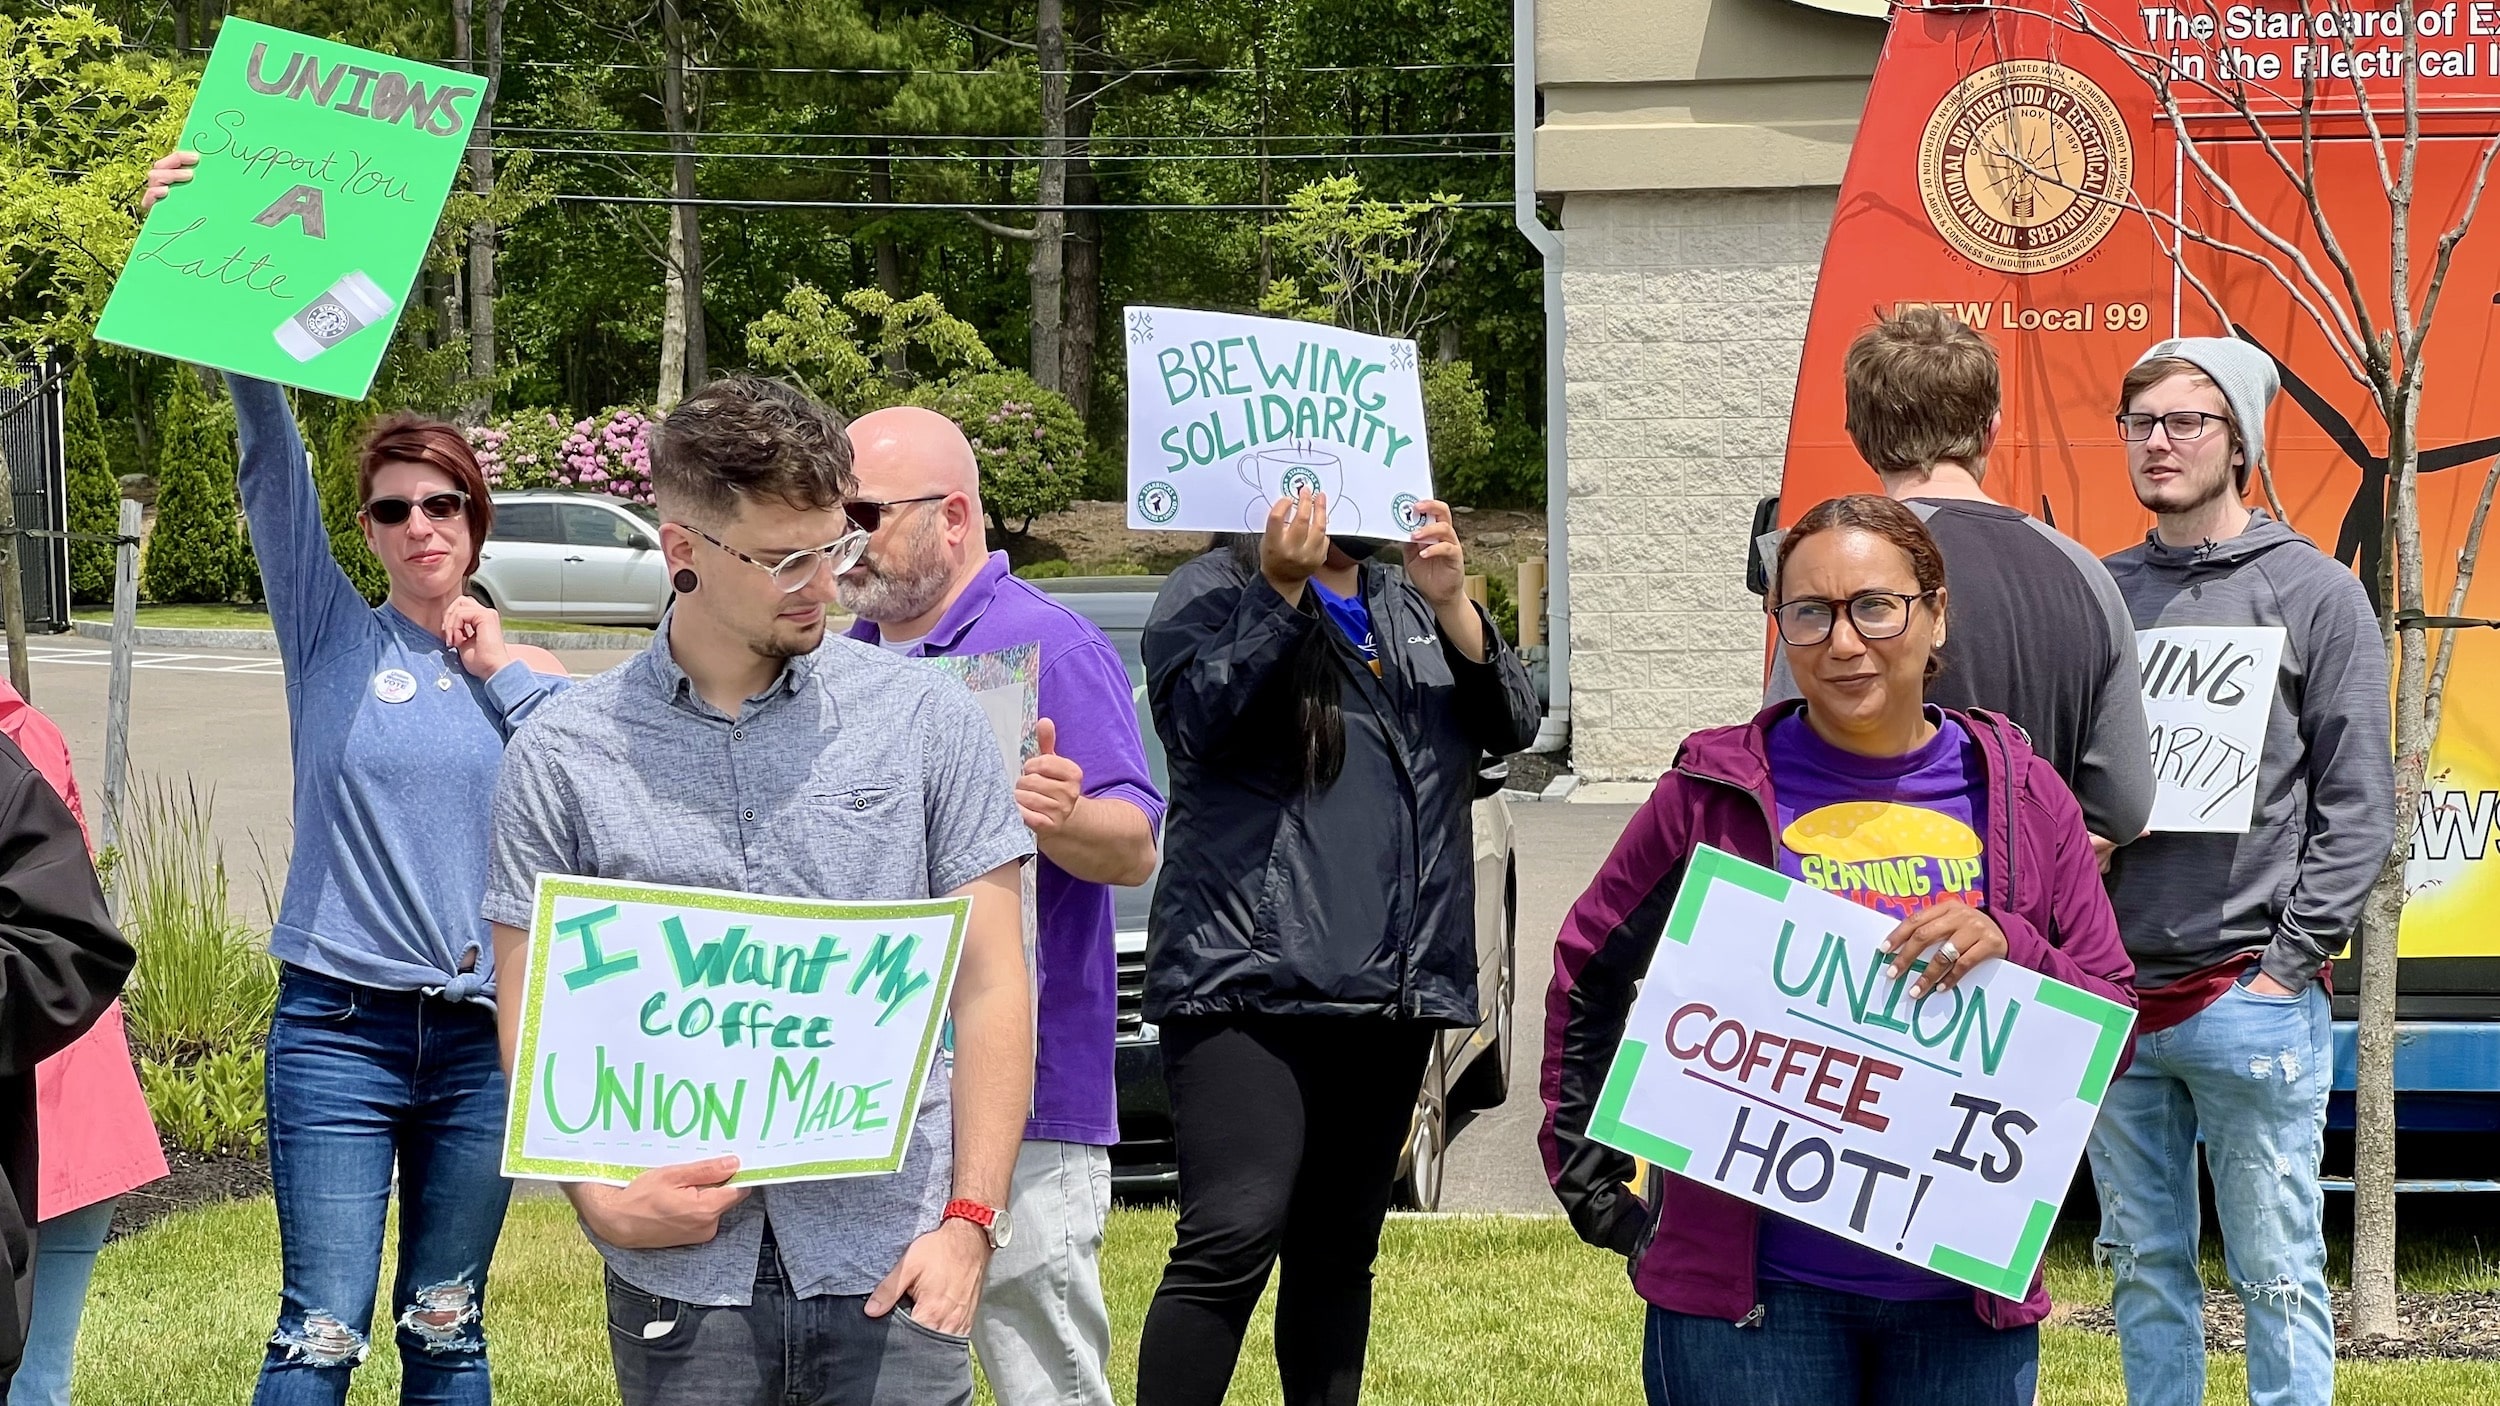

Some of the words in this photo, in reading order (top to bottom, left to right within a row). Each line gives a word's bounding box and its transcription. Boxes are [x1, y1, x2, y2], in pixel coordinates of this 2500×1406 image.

[2140, 7, 2215, 40] The
[2416, 2, 2457, 36] of
[2469, 1, 2500, 36] E
[2170, 47, 2206, 81] in
[2218, 46, 2281, 80] the
[2292, 42, 2476, 79] Electrcal
[246, 42, 477, 136] UNIONS
[2047, 92, 2069, 112] OF
[2077, 81, 2112, 117] CONGRESS
[1949, 86, 2045, 149] BROTHERHOOD
[1970, 112, 2014, 155] ORGANIZE
[2021, 109, 2045, 121] NOV.
[2066, 133, 2080, 154] 1891
[2110, 119, 2126, 152] LABOUR
[193, 110, 338, 182] Support
[340, 150, 414, 202] You
[1923, 121, 1941, 175] FEDERATION
[2065, 105, 2105, 190] ELECTRICAL
[1924, 178, 1932, 189] OF
[1945, 153, 2016, 245] INTERNATIONAL
[2114, 157, 2127, 199] ANDIAN
[251, 184, 326, 239] A
[1927, 193, 1942, 220] LABOR
[1940, 220, 1946, 228] &
[2028, 195, 2096, 246] WORKERS
[136, 217, 294, 298] Latte
[1945, 227, 1983, 258] CONGRESS
[1985, 253, 1996, 262] OF
[2050, 215, 2110, 263] ORGANIZATIONS
[2002, 302, 2094, 331] Local
[2104, 303, 2149, 331] 99
[1158, 335, 1387, 412] BREWING
[1160, 394, 1413, 473] SOLIDARITY
[1938, 858, 1981, 892] UP
[555, 904, 640, 992] I
[659, 915, 849, 994] Want
[848, 932, 932, 1027] My
[1773, 919, 2021, 1076] UNION
[543, 1045, 747, 1141] UNION
[760, 1056, 893, 1141] MADE
[1665, 1003, 1904, 1133] COFFEE
[1932, 1092, 2038, 1184] IS
[1715, 1106, 1933, 1251] HOT!
